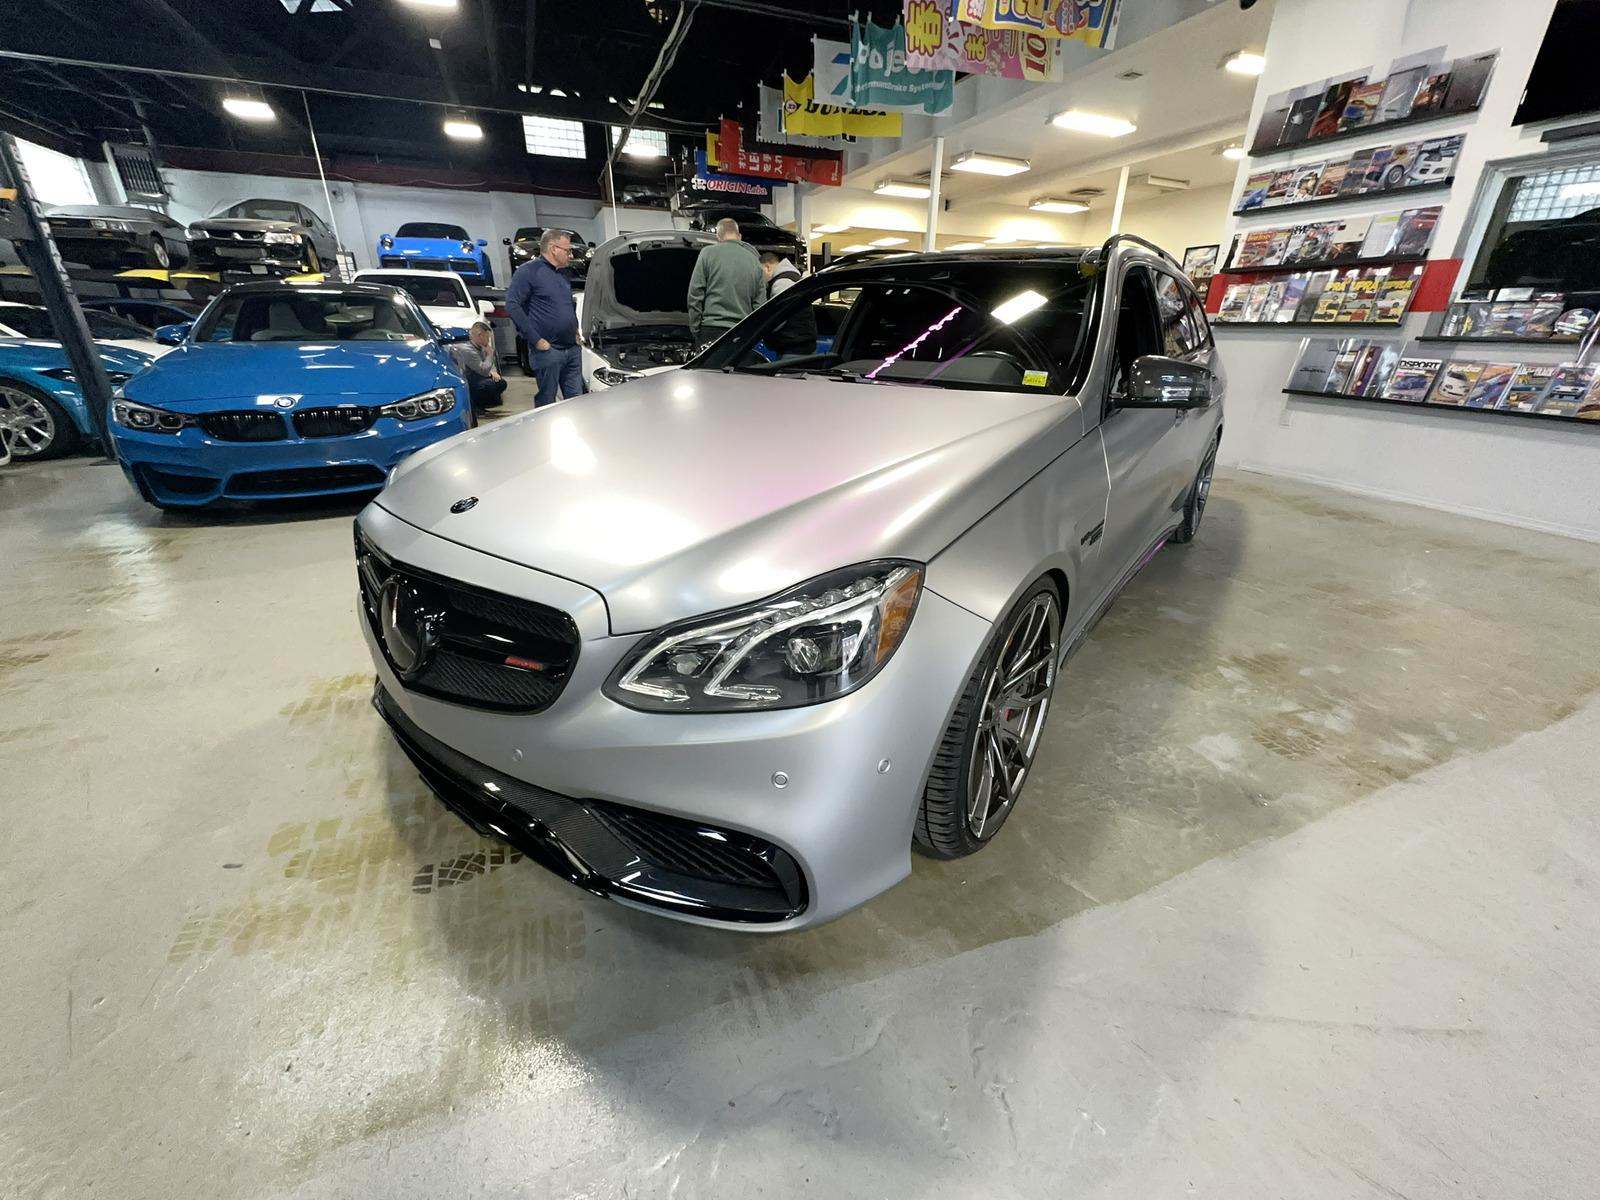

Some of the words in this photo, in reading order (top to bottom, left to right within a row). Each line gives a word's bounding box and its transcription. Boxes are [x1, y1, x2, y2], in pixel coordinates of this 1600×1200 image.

[905, 1, 943, 57] 春
[707, 179, 747, 193] ORIGIN
[1399, 360, 1440, 370] DSPORT
